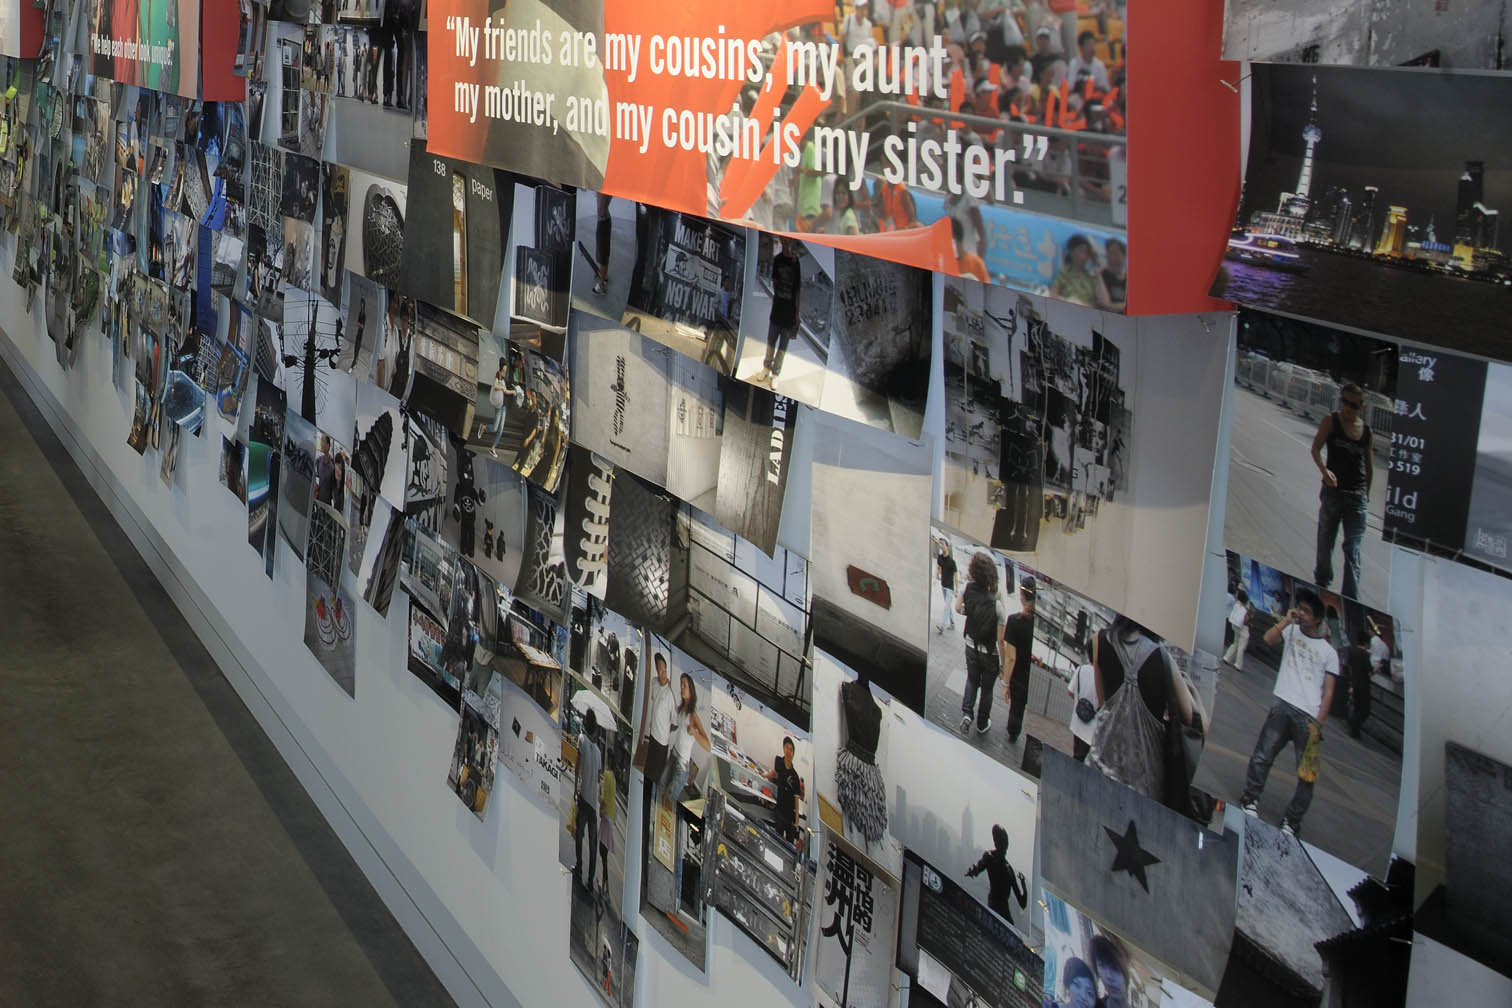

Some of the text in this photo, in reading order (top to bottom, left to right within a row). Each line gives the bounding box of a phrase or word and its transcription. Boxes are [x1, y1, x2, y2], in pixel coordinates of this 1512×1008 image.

[446, 15, 949, 102] “My friends are my cousins, my aunt
[454, 79, 1049, 205] my mother, and my cousin is my sister.”
[432, 158, 446, 177] 138
[471, 178, 494, 202] paper
[674, 222, 721, 263] MAKE ART
[665, 279, 718, 322] NOT WAR
